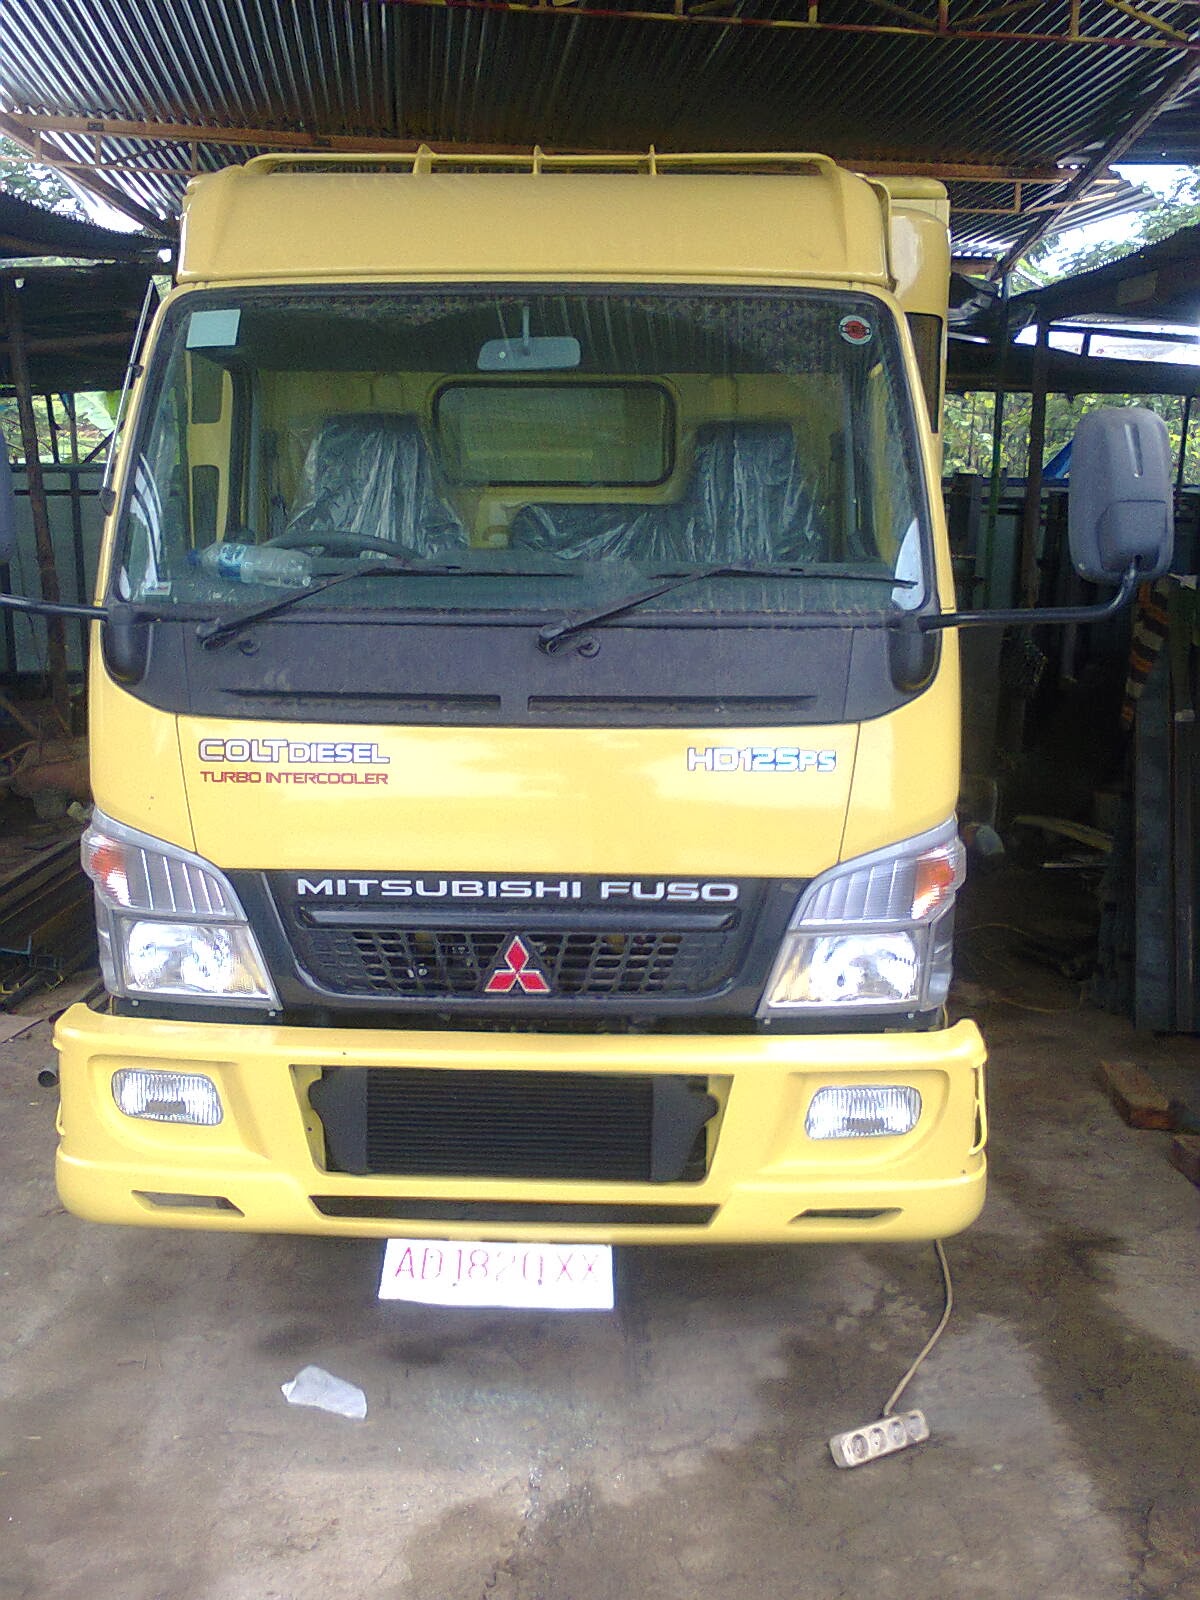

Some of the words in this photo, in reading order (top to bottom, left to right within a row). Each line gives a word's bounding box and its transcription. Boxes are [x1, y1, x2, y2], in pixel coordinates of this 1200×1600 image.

[199, 771, 262, 784] TURBO
[265, 772, 389, 785] INTERCOOLER
[296, 877, 583, 899] MITSUBISHI
[599, 880, 739, 902] FUSO
